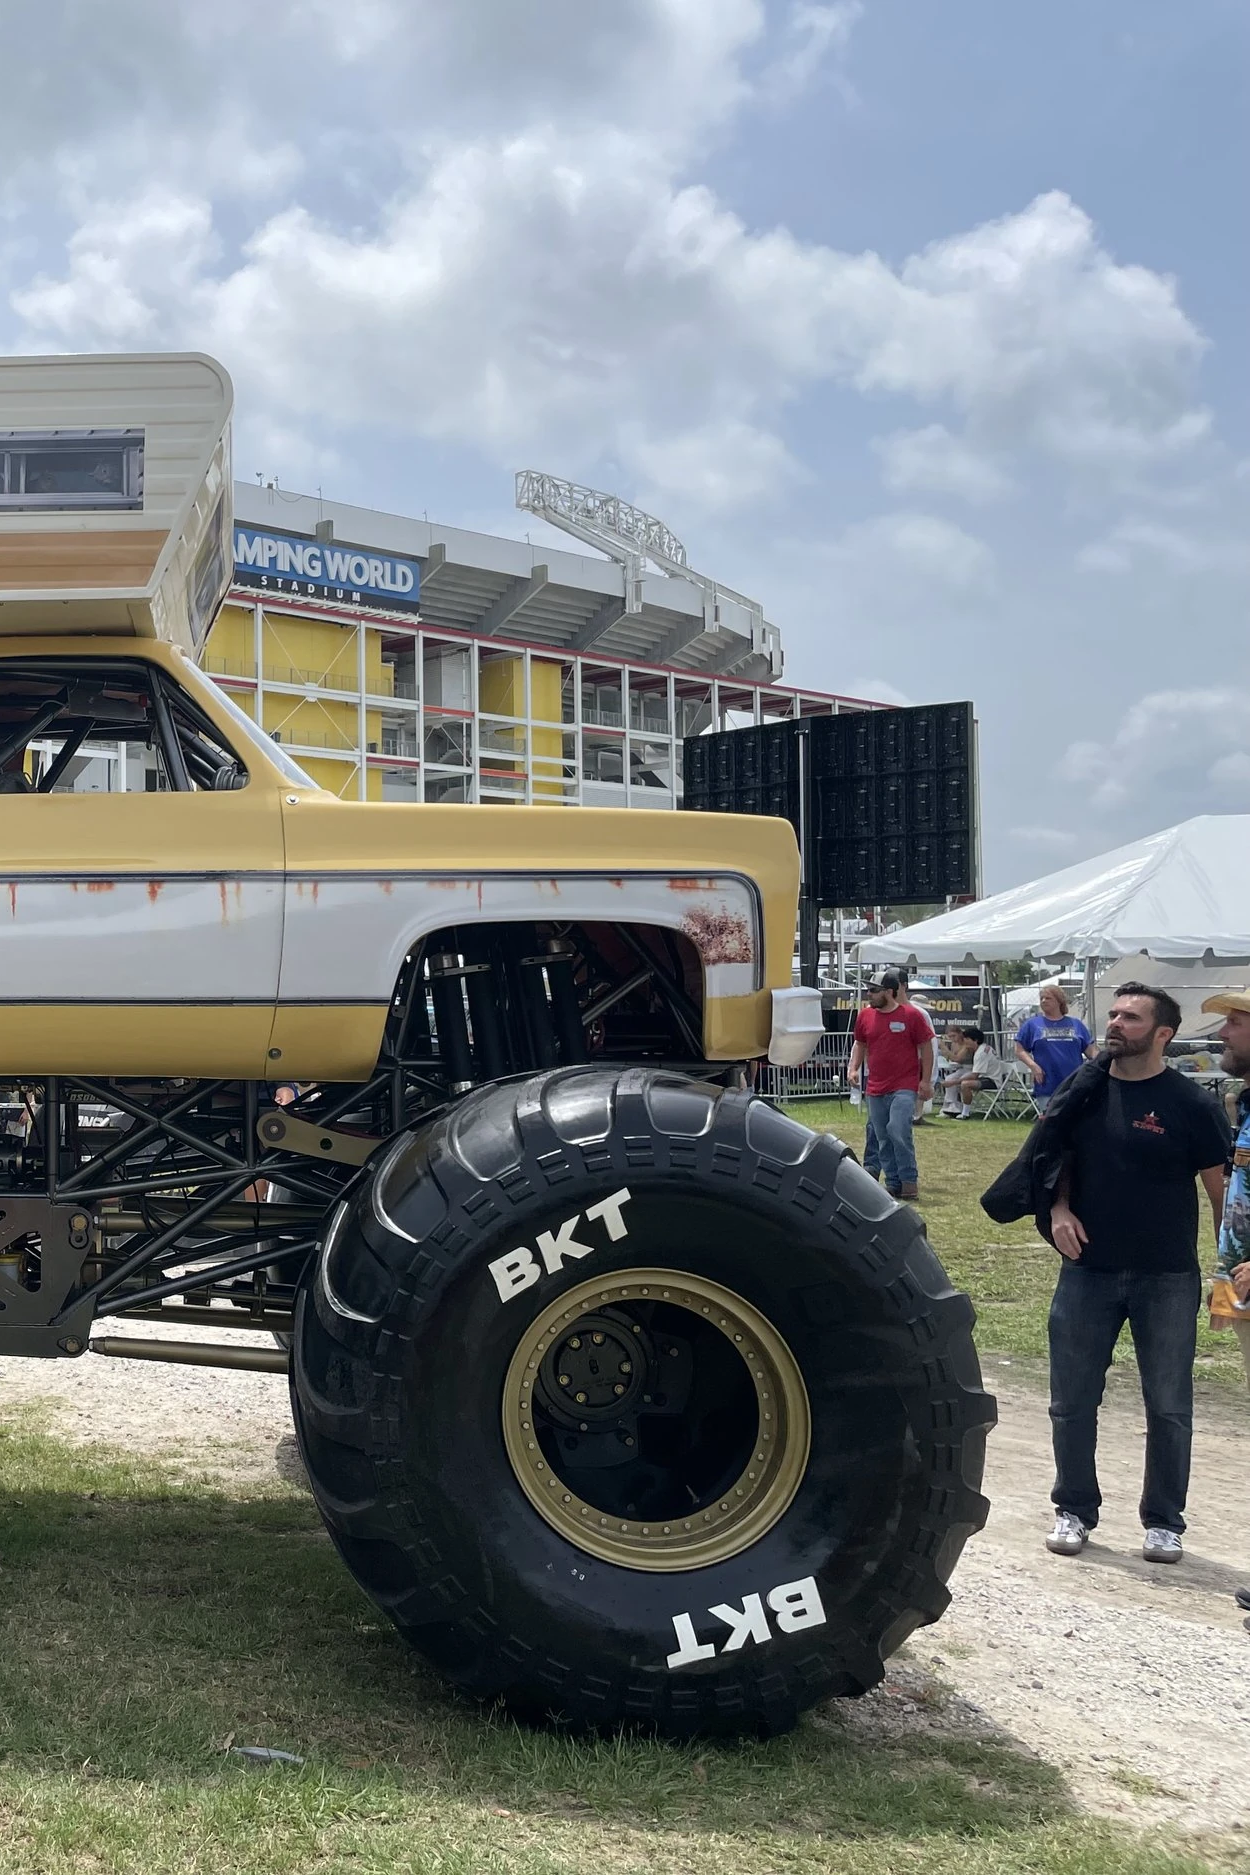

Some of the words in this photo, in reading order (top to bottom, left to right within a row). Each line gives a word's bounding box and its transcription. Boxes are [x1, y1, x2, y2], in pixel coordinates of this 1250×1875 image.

[233, 533, 321, 577] MPING
[323, 550, 414, 593] WORLD
[261, 575, 361, 602] STADIUM
[933, 1017, 946, 1026] the
[946, 1017, 981, 1026] winner
[487, 1187, 632, 1304] BKT
[666, 1575, 827, 1669] BKT
